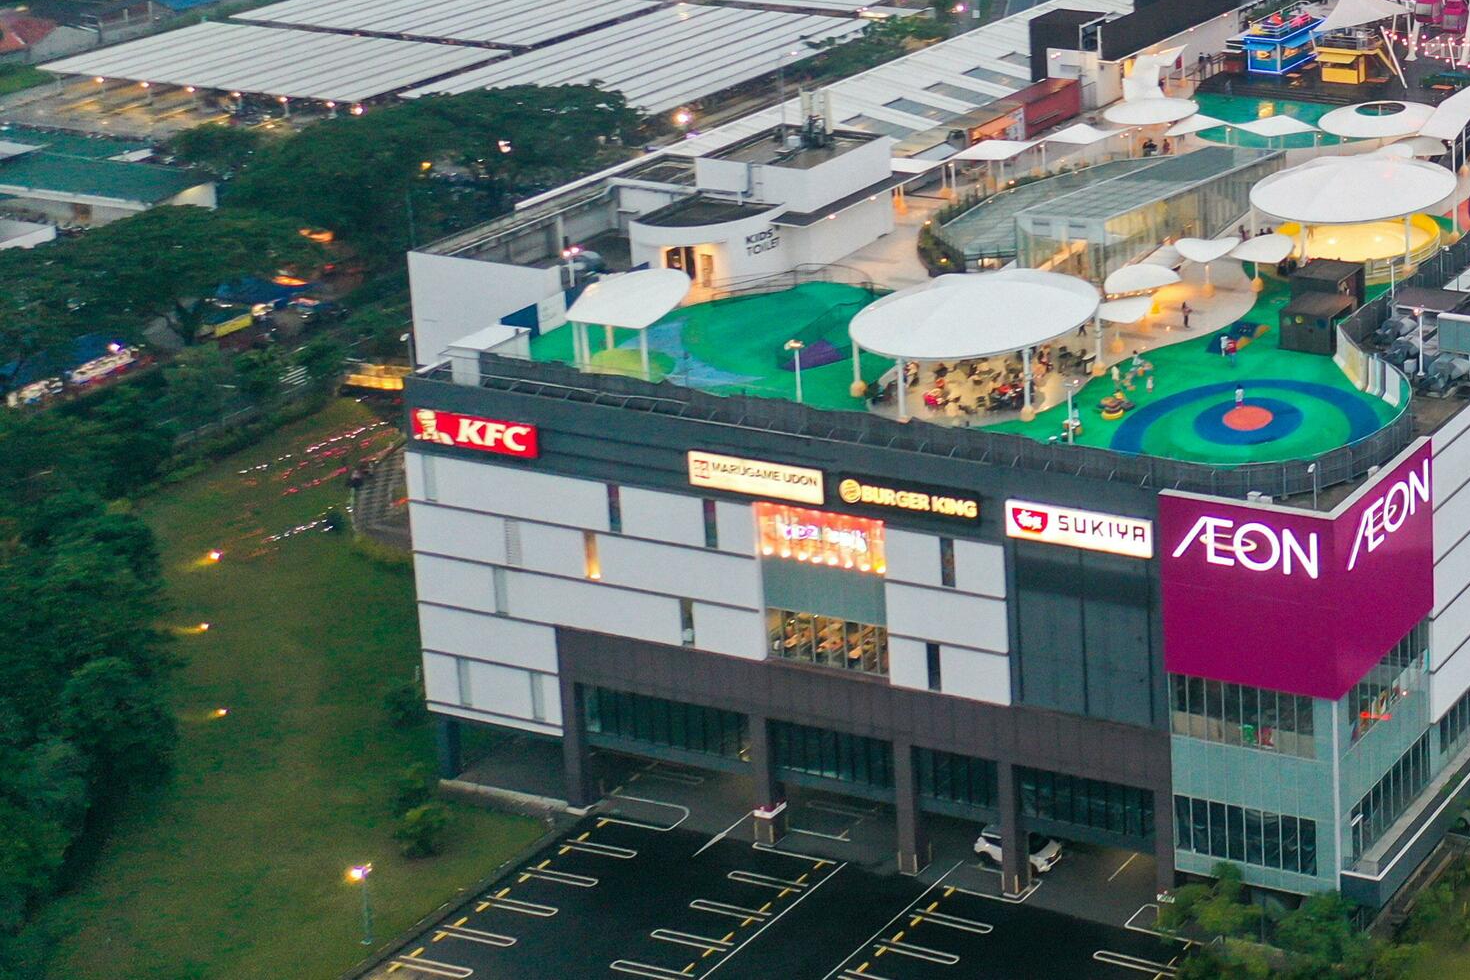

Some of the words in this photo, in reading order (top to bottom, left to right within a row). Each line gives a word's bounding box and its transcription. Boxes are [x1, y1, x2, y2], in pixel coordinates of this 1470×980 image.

[746, 237, 780, 256] TOILET
[456, 419, 531, 451] KFC
[711, 462, 782, 482] MARUGAME
[784, 473, 818, 487] UDON
[861, 485, 930, 511] BURGER
[931, 497, 978, 518] KING
[1058, 515, 1145, 542] SUKIYA
